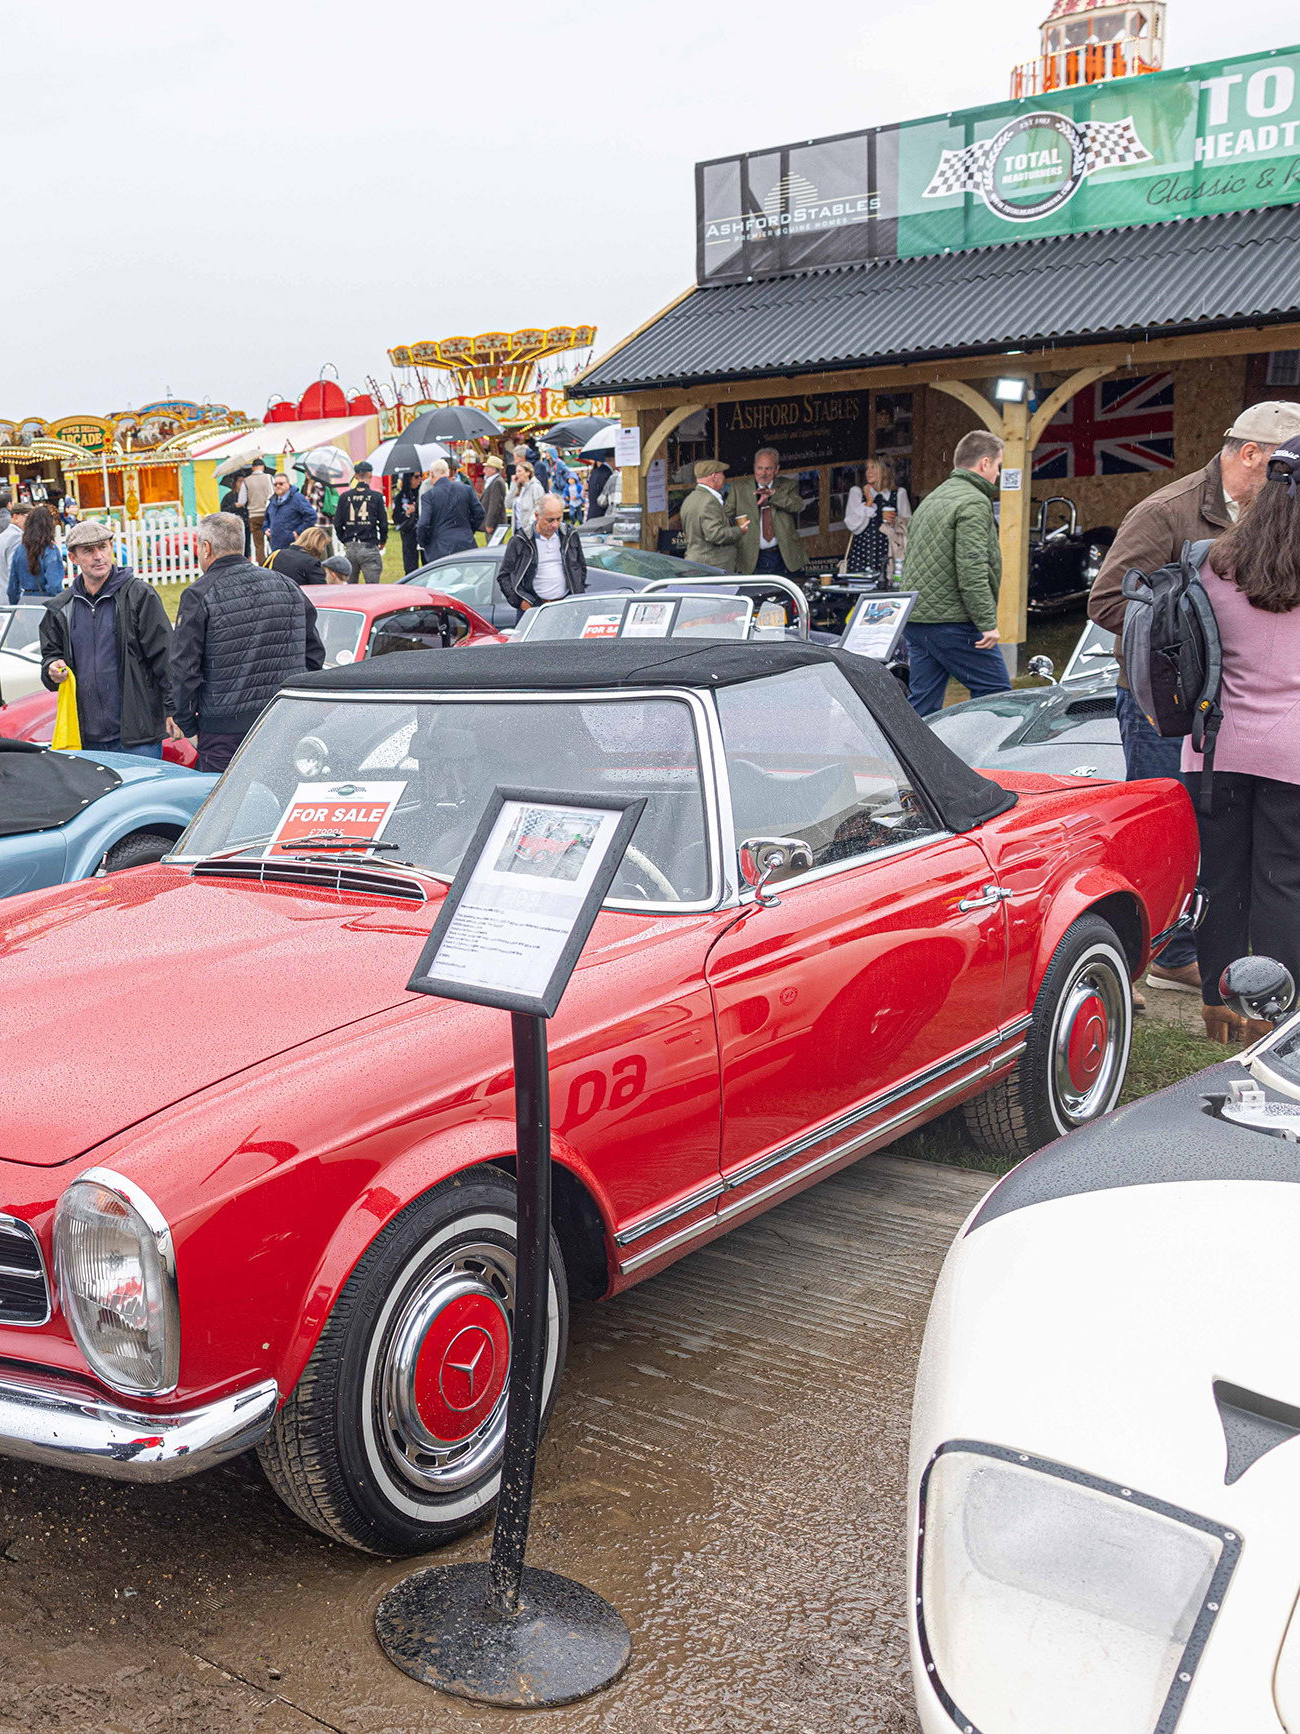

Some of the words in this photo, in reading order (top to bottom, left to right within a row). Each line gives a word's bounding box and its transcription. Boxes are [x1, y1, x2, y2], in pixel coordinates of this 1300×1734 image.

[1003, 148, 1062, 172] TOTAL
[1001, 165, 1063, 184] HEADTURNERS
[1147, 174, 1247, 205] Classic
[1255, 167, 1276, 188] &
[734, 229, 773, 242] PREMIER
[775, 222, 811, 236] EQUINE
[814, 216, 848, 228] HOMES
[730, 400, 799, 430] ASHFORD
[803, 393, 860, 424] STABLES
[61, 432, 103, 447] ARCADE
[350, 500, 369, 521] 14
[585, 626, 604, 634] FOR
[288, 808, 329, 822] FOR
[331, 808, 385, 823] SALE
